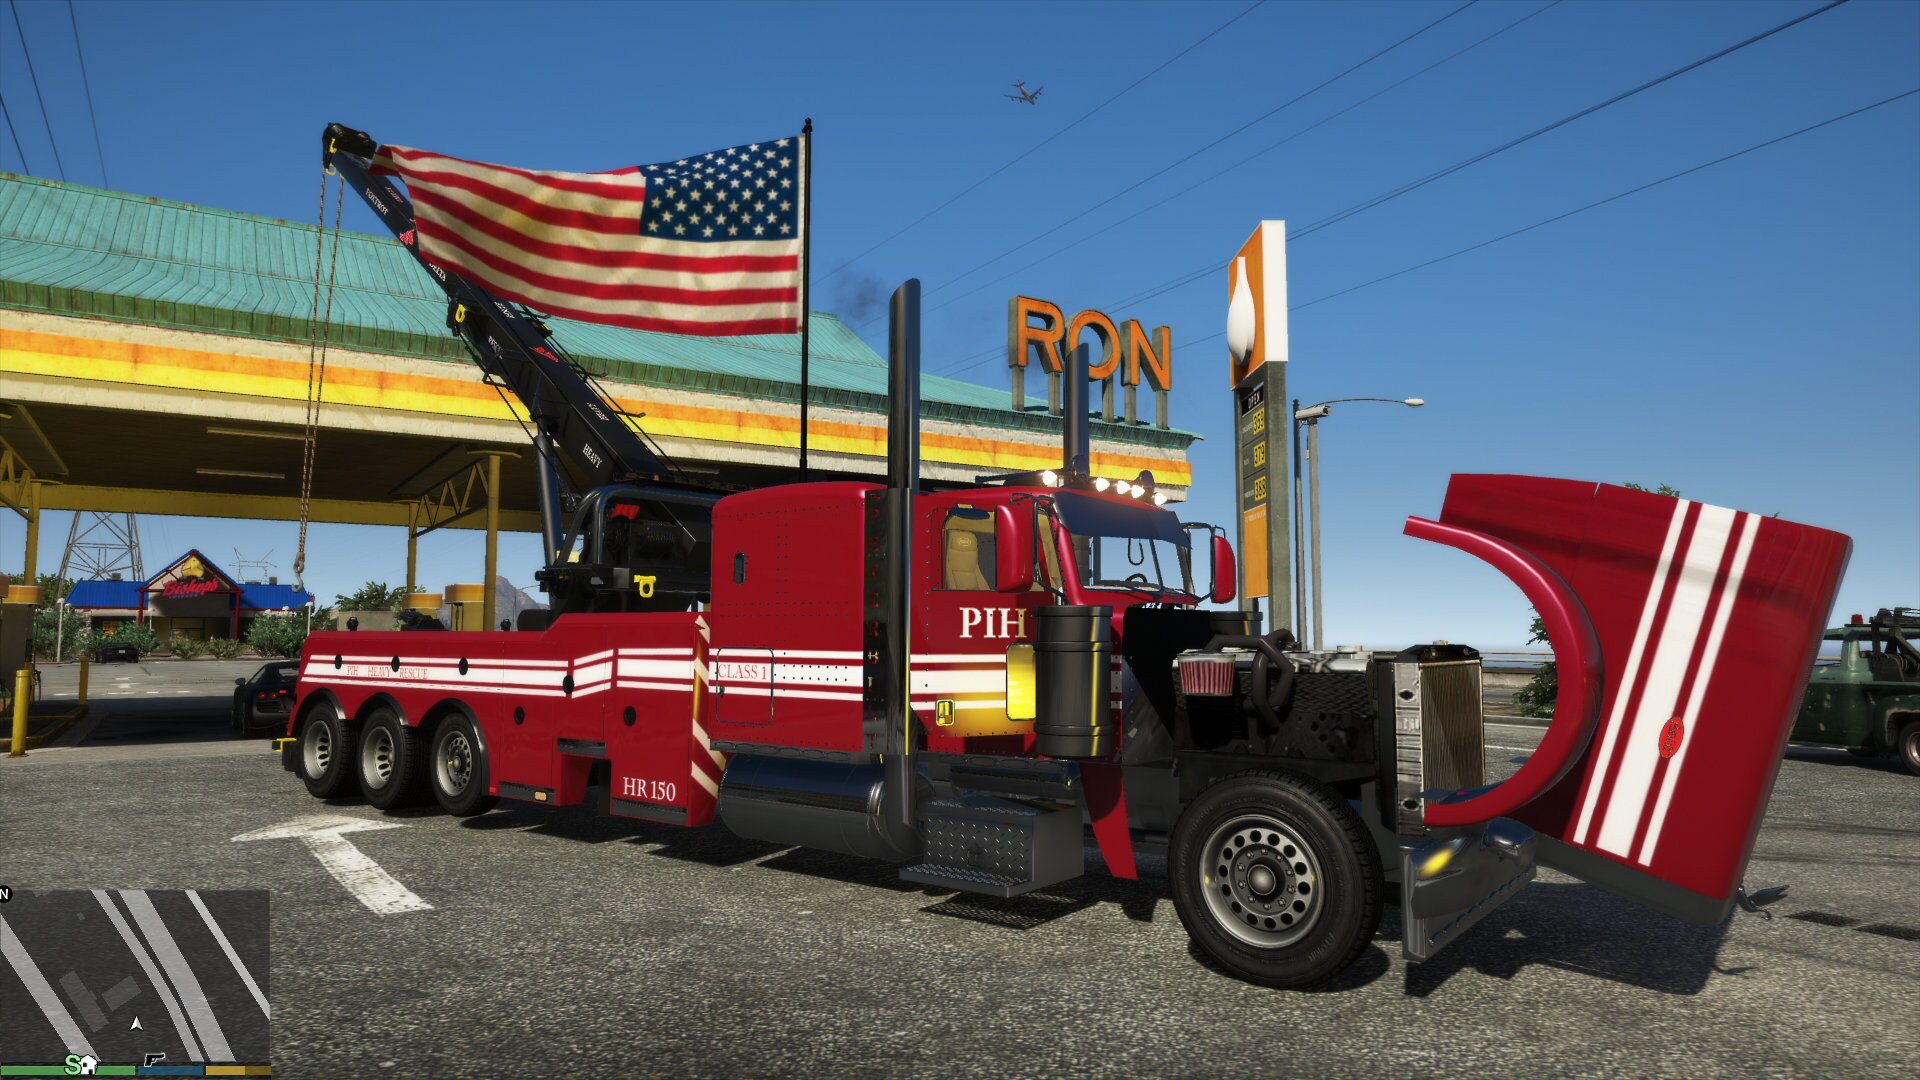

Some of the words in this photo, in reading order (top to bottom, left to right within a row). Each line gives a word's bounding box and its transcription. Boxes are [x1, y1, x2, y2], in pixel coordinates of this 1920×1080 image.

[365, 187, 389, 216] FOXTROT
[1008, 295, 1171, 392] RON
[582, 443, 602, 469] HEAVY
[959, 607, 1028, 638] PIH
[368, 665, 391, 678] HEAVY
[399, 667, 428, 680] RESCUE
[718, 663, 758, 680] CLASS
[760, 666, 767, 680] 1
[623, 776, 648, 799] HR
[650, 780, 676, 802] 150
